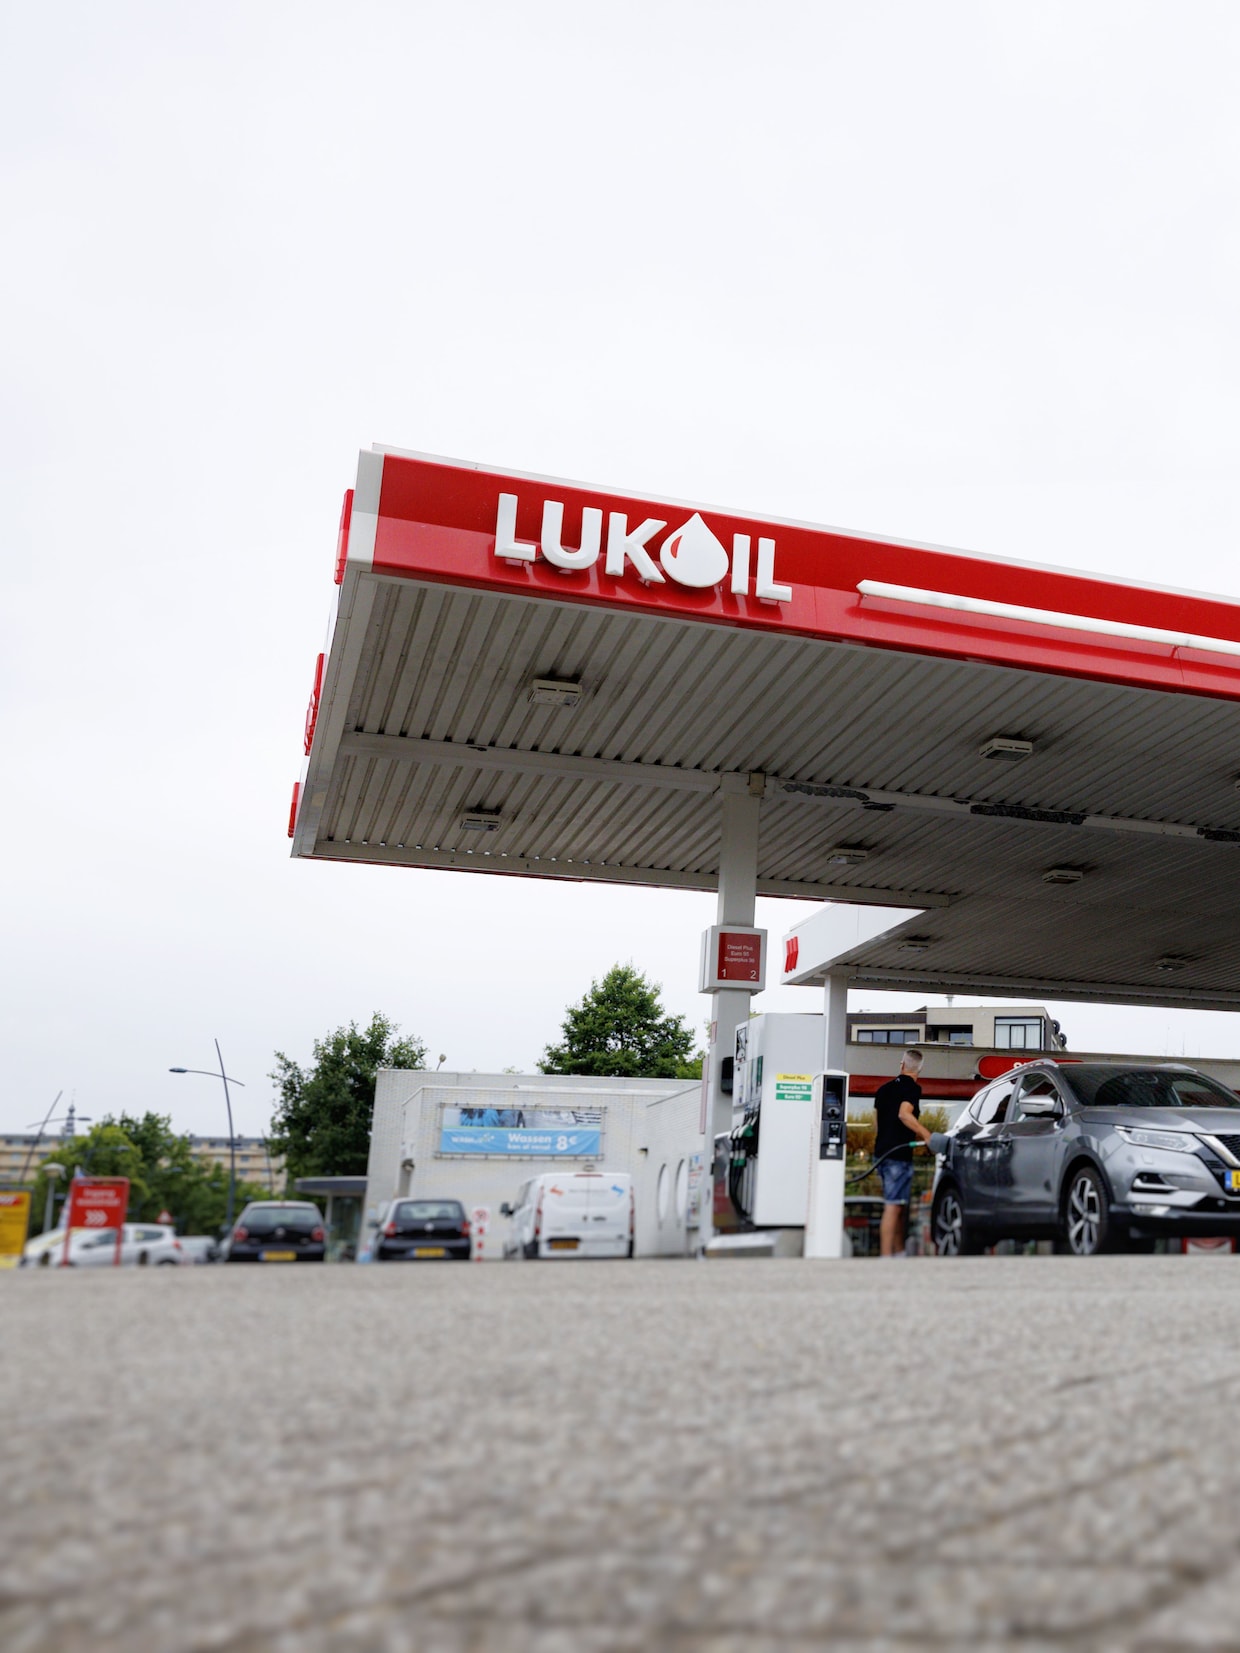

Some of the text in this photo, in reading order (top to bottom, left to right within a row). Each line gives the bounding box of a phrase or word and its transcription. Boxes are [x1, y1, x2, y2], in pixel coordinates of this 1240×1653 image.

[493, 492, 793, 604] LUKOIL
[721, 968, 727, 978] 1
[750, 970, 757, 980] 2
[508, 1133, 552, 1144] Wassen
